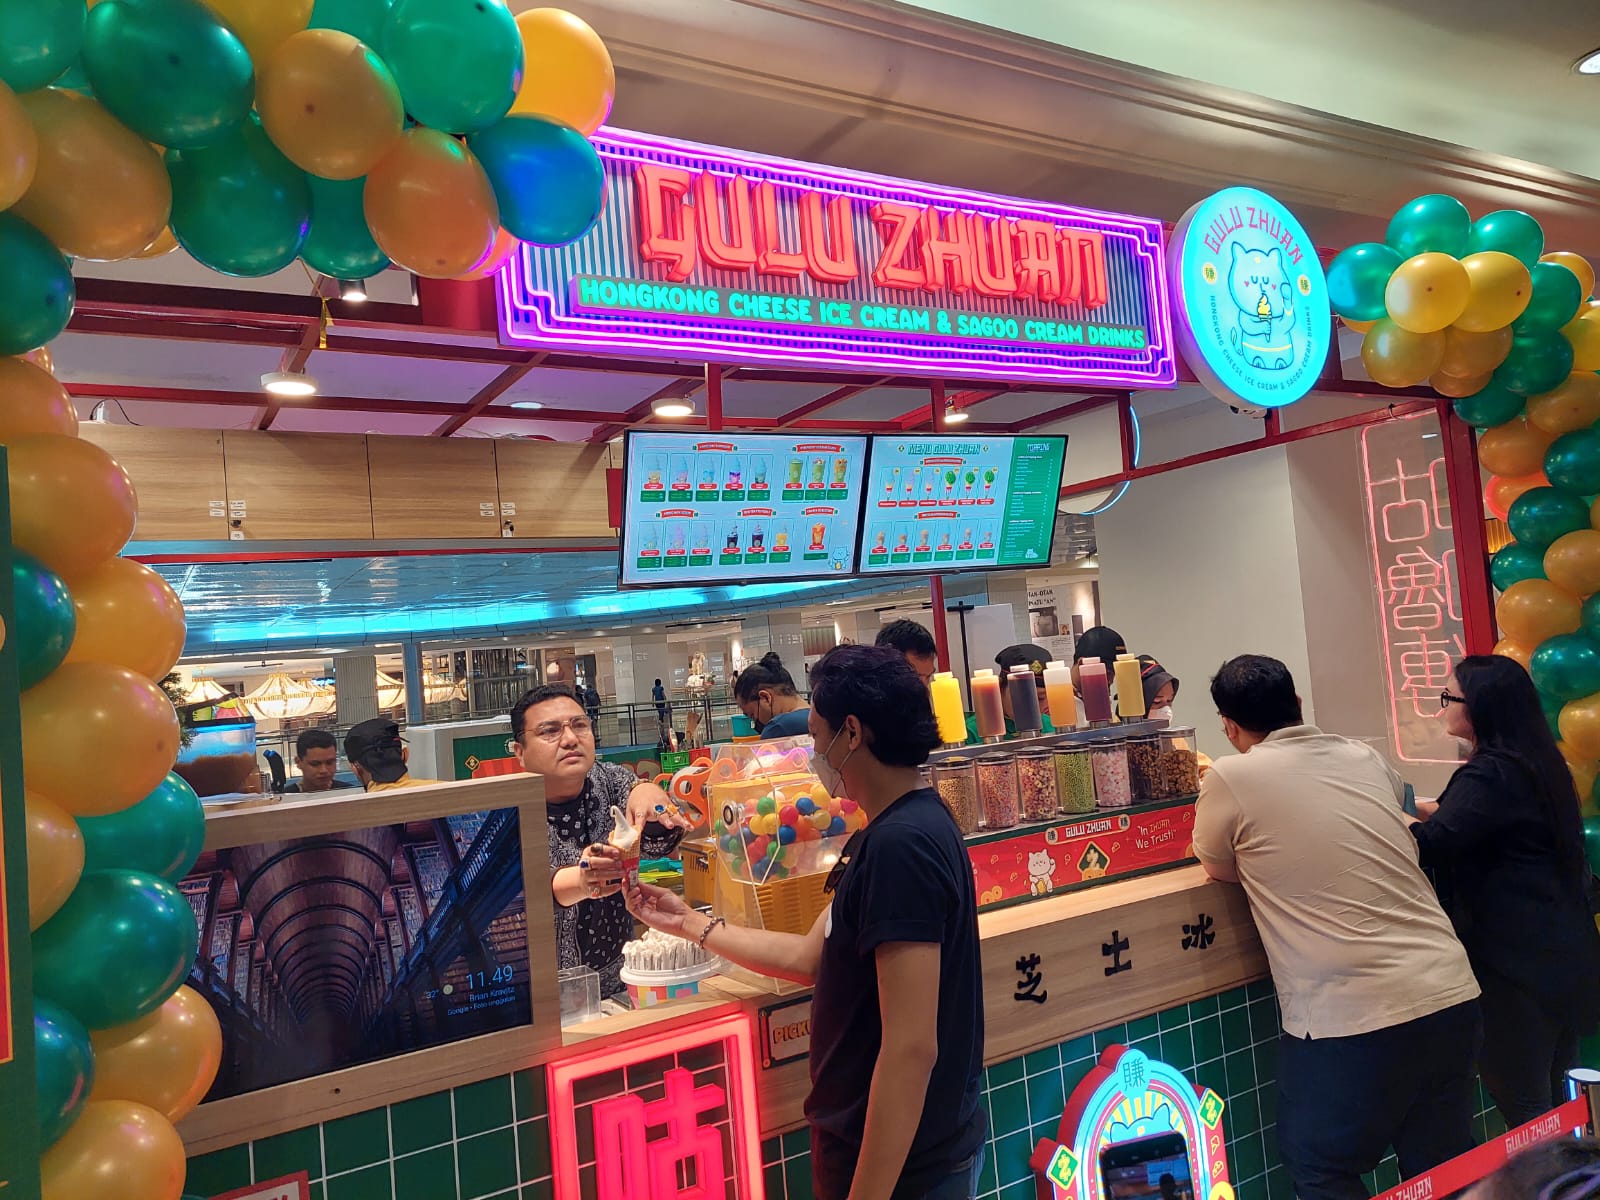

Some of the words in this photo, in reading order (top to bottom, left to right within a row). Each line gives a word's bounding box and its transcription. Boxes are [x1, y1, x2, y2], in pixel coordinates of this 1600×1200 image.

[634, 163, 860, 283] GULU
[870, 201, 1107, 311] ZHUAN
[1204, 206, 1244, 255] GULU
[1247, 207, 1304, 265] ZHUAN
[580, 279, 720, 314] HONGKONG
[729, 293, 812, 322] CHEESE
[820, 302, 853, 326] ICE
[860, 305, 930, 332] CREAM
[937, 313, 951, 334] &
[958, 315, 1018, 339] SAGOO
[1025, 320, 1083, 344] CREAM
[1088, 326, 1145, 348] DRINKS
[1065, 824, 1086, 838] GULU
[1086, 819, 1112, 834] ZHUAN
[1136, 839, 1149, 849] We
[465, 964, 513, 990] 11.49
[470, 991, 489, 1001] Brian
[1504, 1129, 1528, 1154] GULU
[1530, 1113, 1561, 1141] ZHUAN
[1396, 1176, 1432, 1200] ZHUAN
